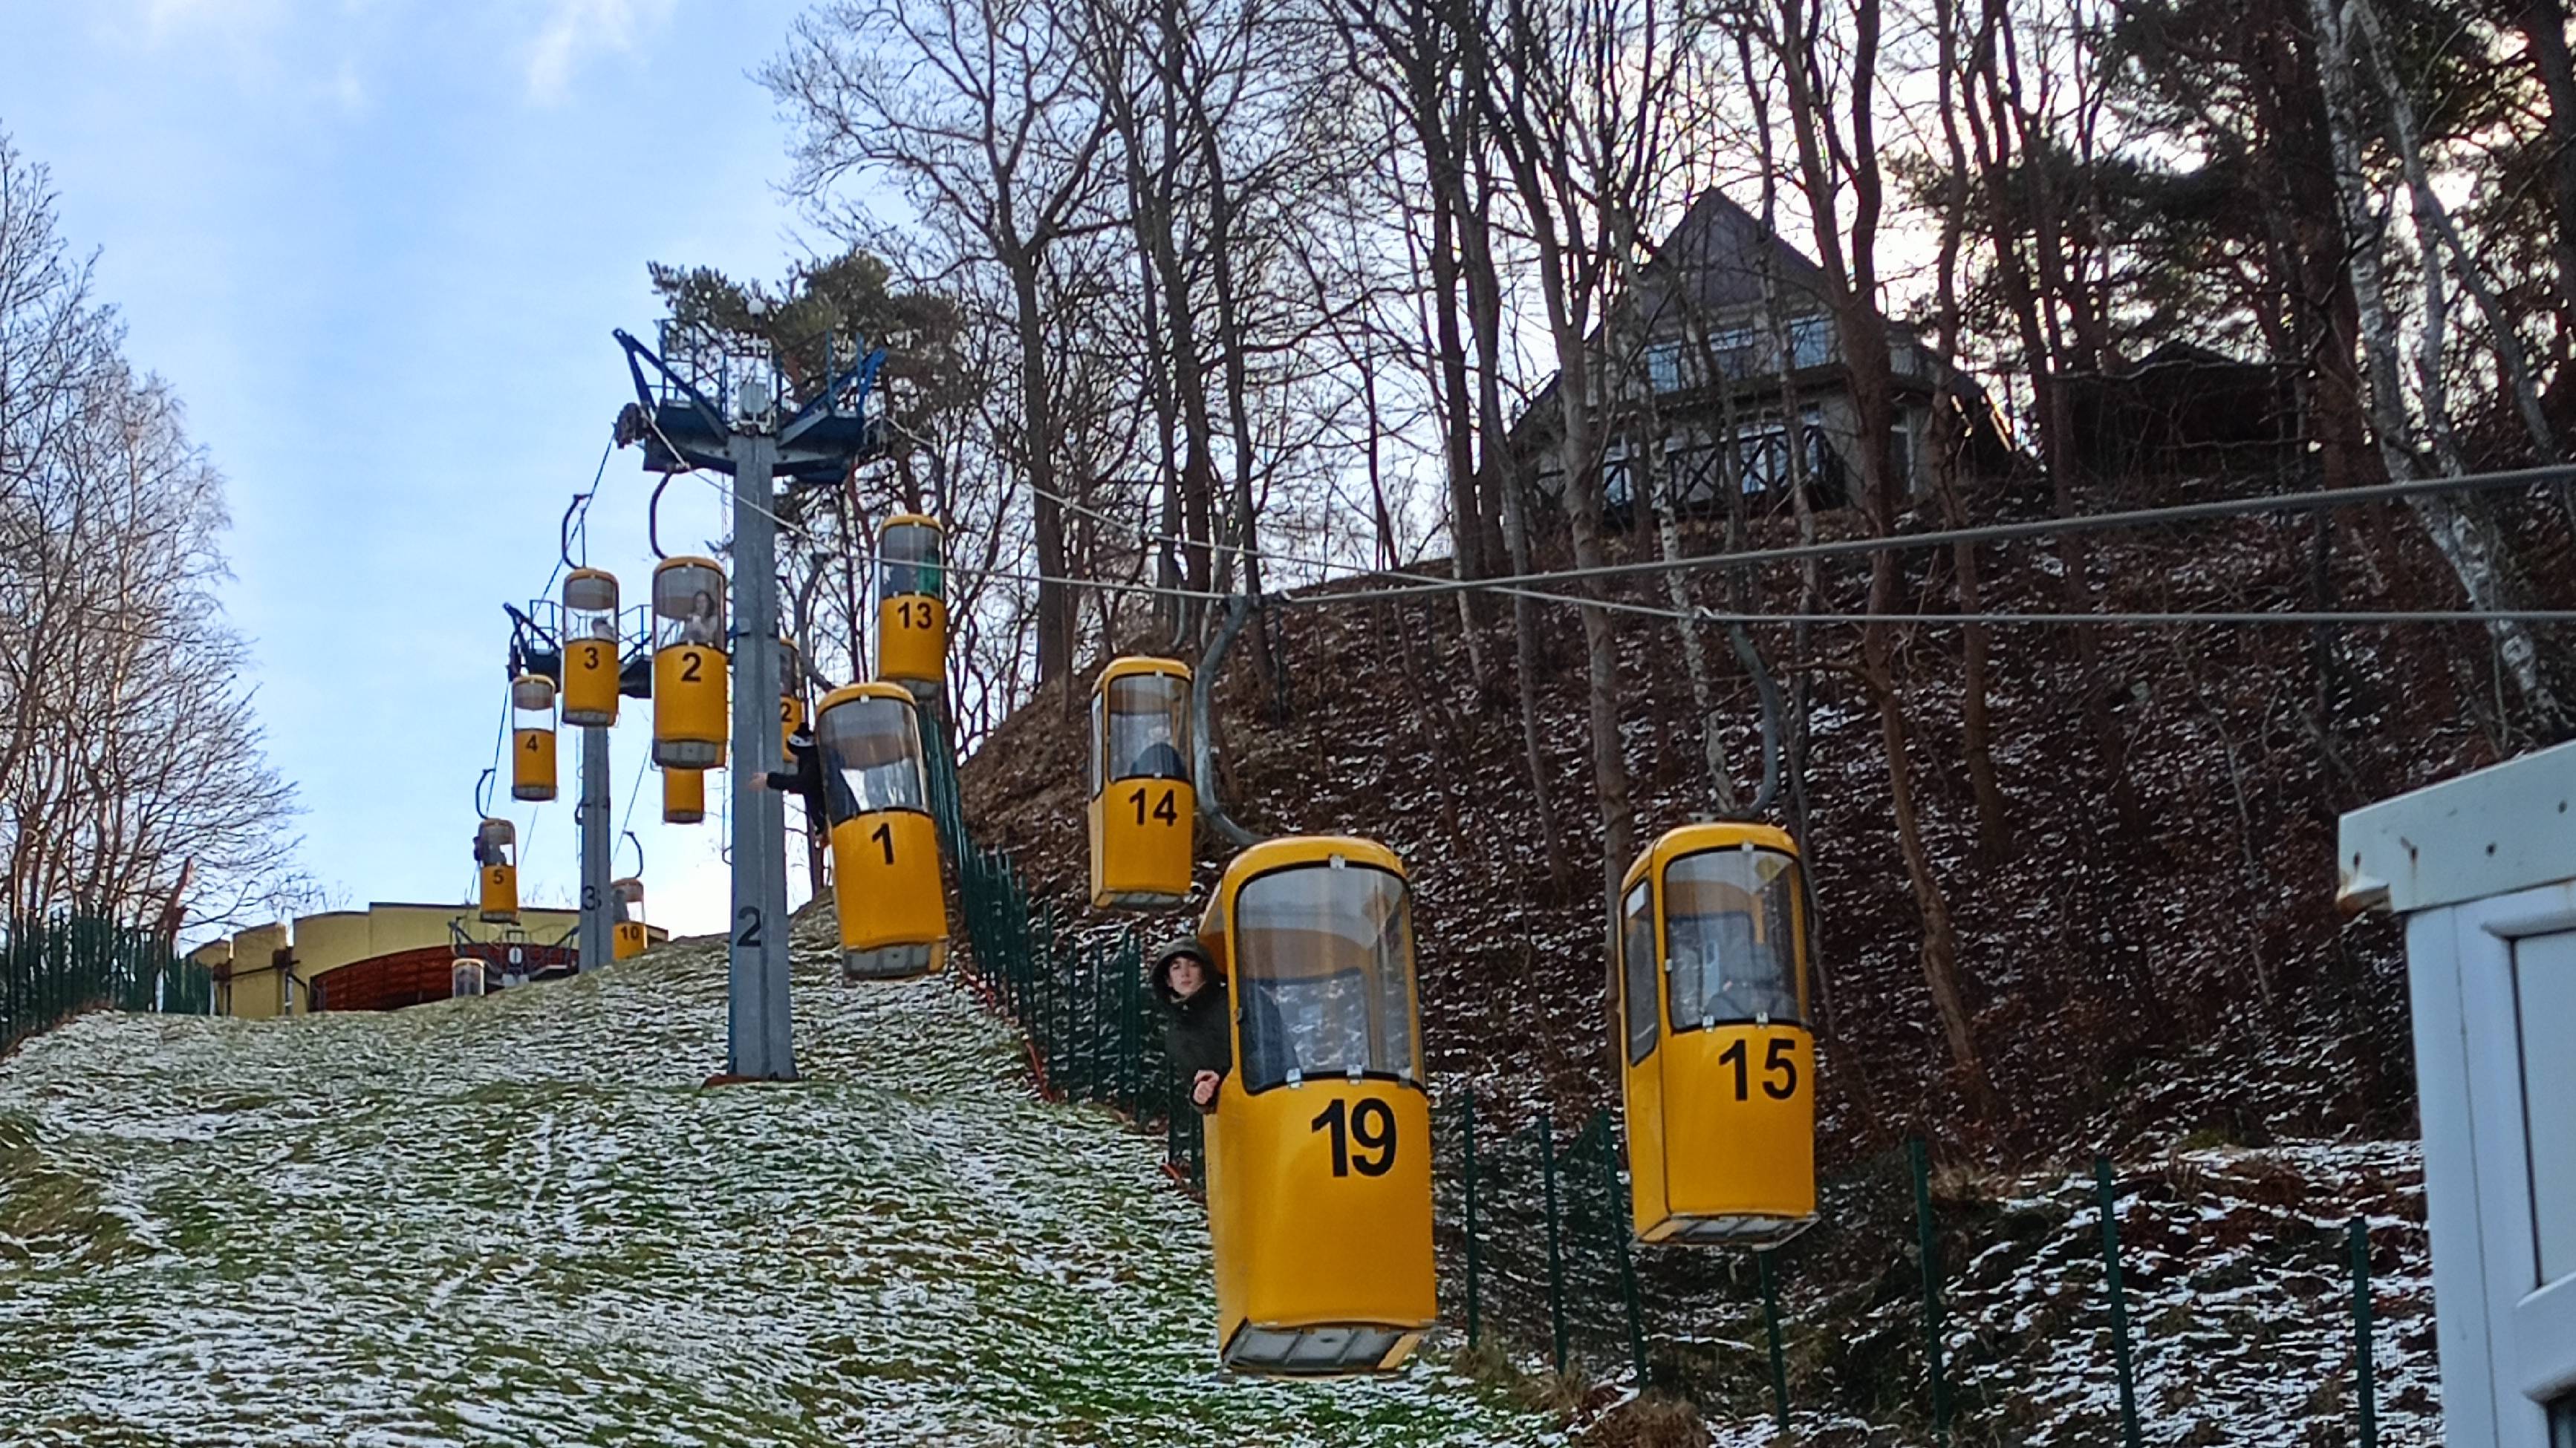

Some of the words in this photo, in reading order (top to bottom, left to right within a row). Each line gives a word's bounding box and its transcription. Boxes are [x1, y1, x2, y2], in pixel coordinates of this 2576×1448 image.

[897, 601, 934, 630] 13
[585, 647, 598, 670] 3
[681, 651, 702, 682] 2
[780, 702, 793, 723] 2
[526, 734, 539, 753] 4
[1129, 787, 1178, 827] 14
[871, 822, 896, 865] 1
[493, 870, 504, 885] 5
[582, 886, 601, 910] 3
[620, 925, 640, 941] 10
[736, 906, 762, 948] 2
[1719, 1038, 1798, 1102] 15
[1311, 1098, 1397, 1178] 19
